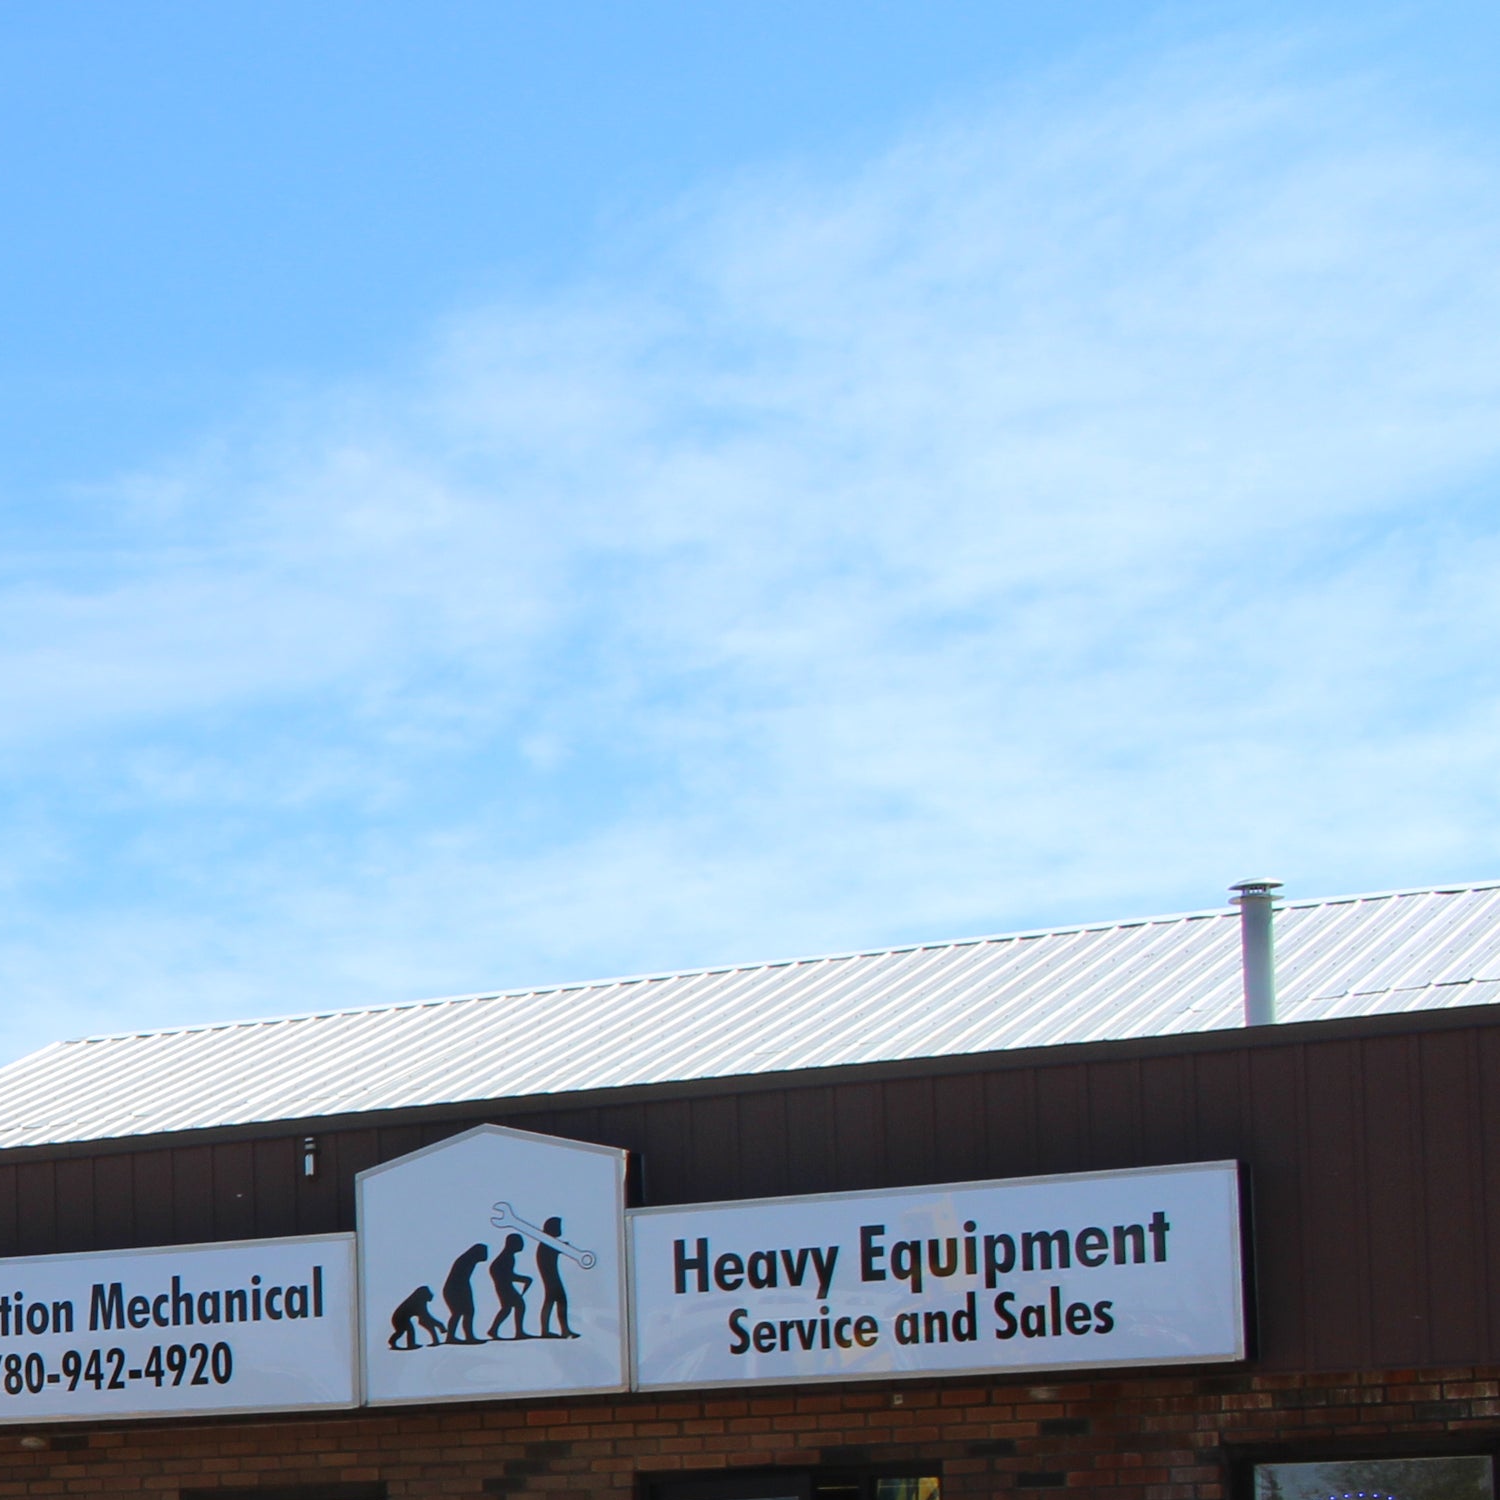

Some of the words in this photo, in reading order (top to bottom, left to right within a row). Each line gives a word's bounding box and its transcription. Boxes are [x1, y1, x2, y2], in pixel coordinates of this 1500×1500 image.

[673, 1237, 840, 1299] Heavy
[860, 1211, 1171, 1292] Equipment
[89, 1265, 325, 1333] Mechanical
[728, 1306, 880, 1355] Service
[895, 1292, 978, 1345] and
[995, 1285, 1115, 1339] Sales
